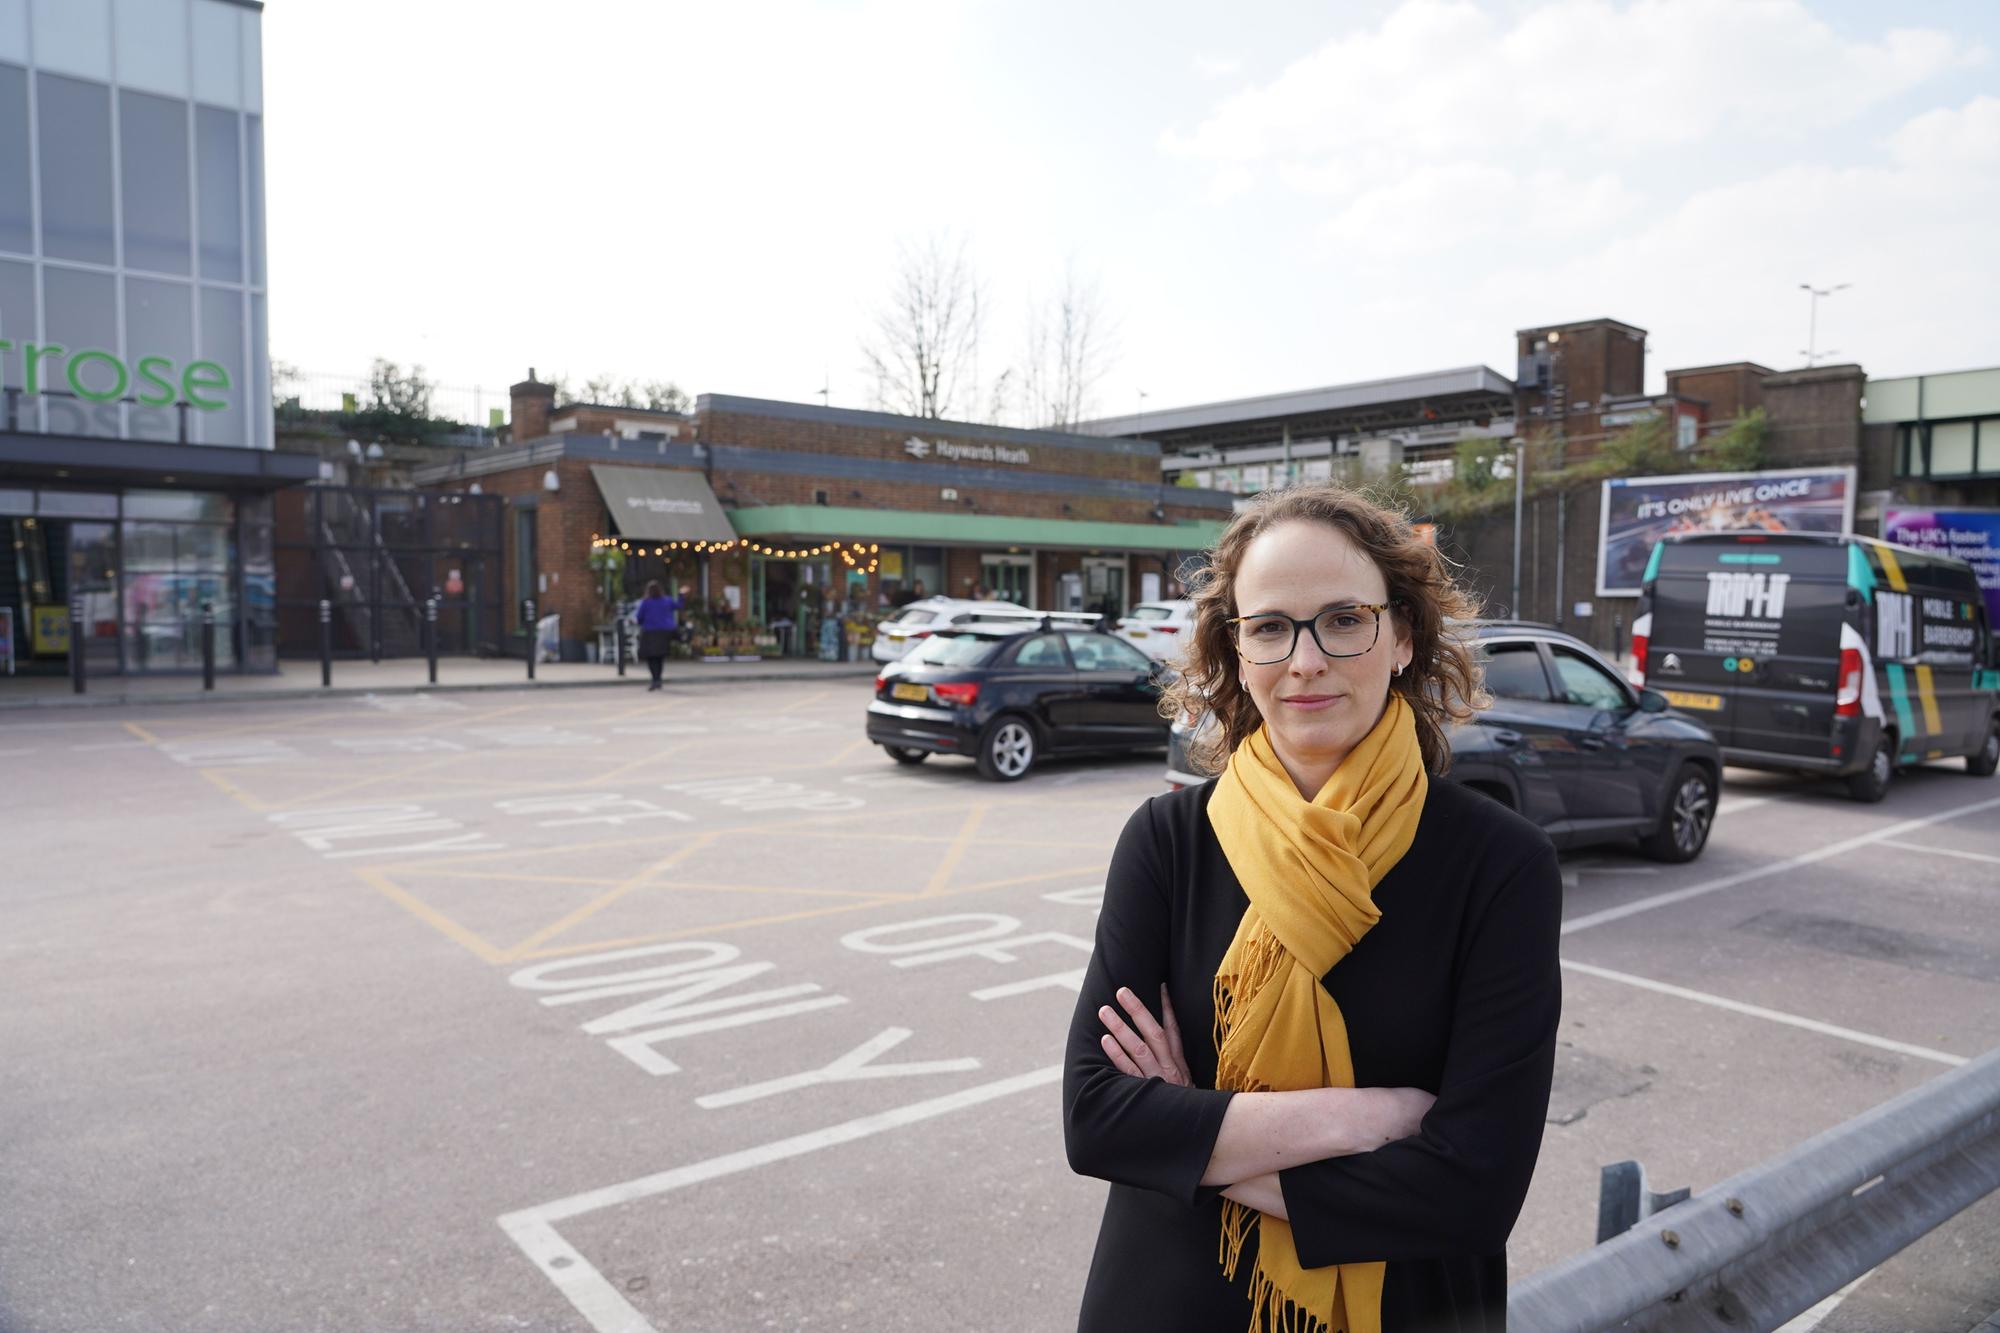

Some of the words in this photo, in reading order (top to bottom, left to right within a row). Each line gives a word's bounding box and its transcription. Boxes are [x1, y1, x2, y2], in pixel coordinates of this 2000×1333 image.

[0, 339, 231, 411] rose
[936, 440, 994, 461] Haywards
[995, 446, 1030, 464] Heath
[1637, 501, 1667, 519] IT'S
[1668, 494, 1717, 515] ONLY
[1717, 487, 1755, 508] LIVE
[1756, 479, 1812, 501] ONCE
[508, 941, 982, 1109] ONLY
